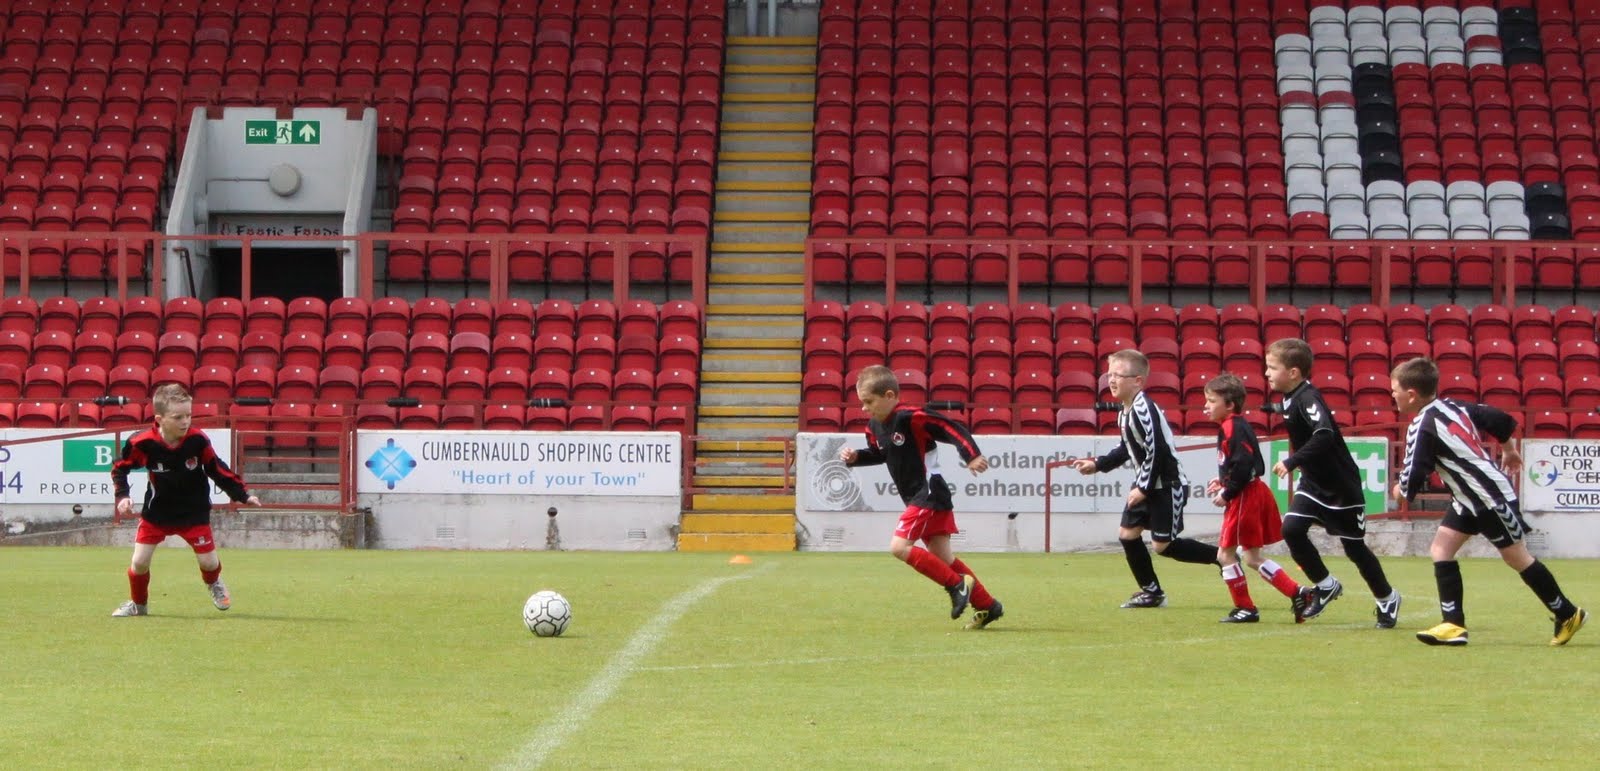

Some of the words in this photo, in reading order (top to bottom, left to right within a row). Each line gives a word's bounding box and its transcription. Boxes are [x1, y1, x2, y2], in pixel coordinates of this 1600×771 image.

[248, 127, 268, 137] Exit
[422, 441, 530, 462] CUMBERNAULD
[538, 442, 612, 463] SHOPPING
[619, 443, 672, 463] CENTRE
[1563, 458, 1593, 470] FOR
[452, 469, 510, 486] "Heart
[517, 470, 535, 486] of
[545, 475, 585, 488] your
[591, 471, 646, 487] Town"
[964, 479, 1122, 497] enhancement
[1556, 492, 1600, 505] CUMB
